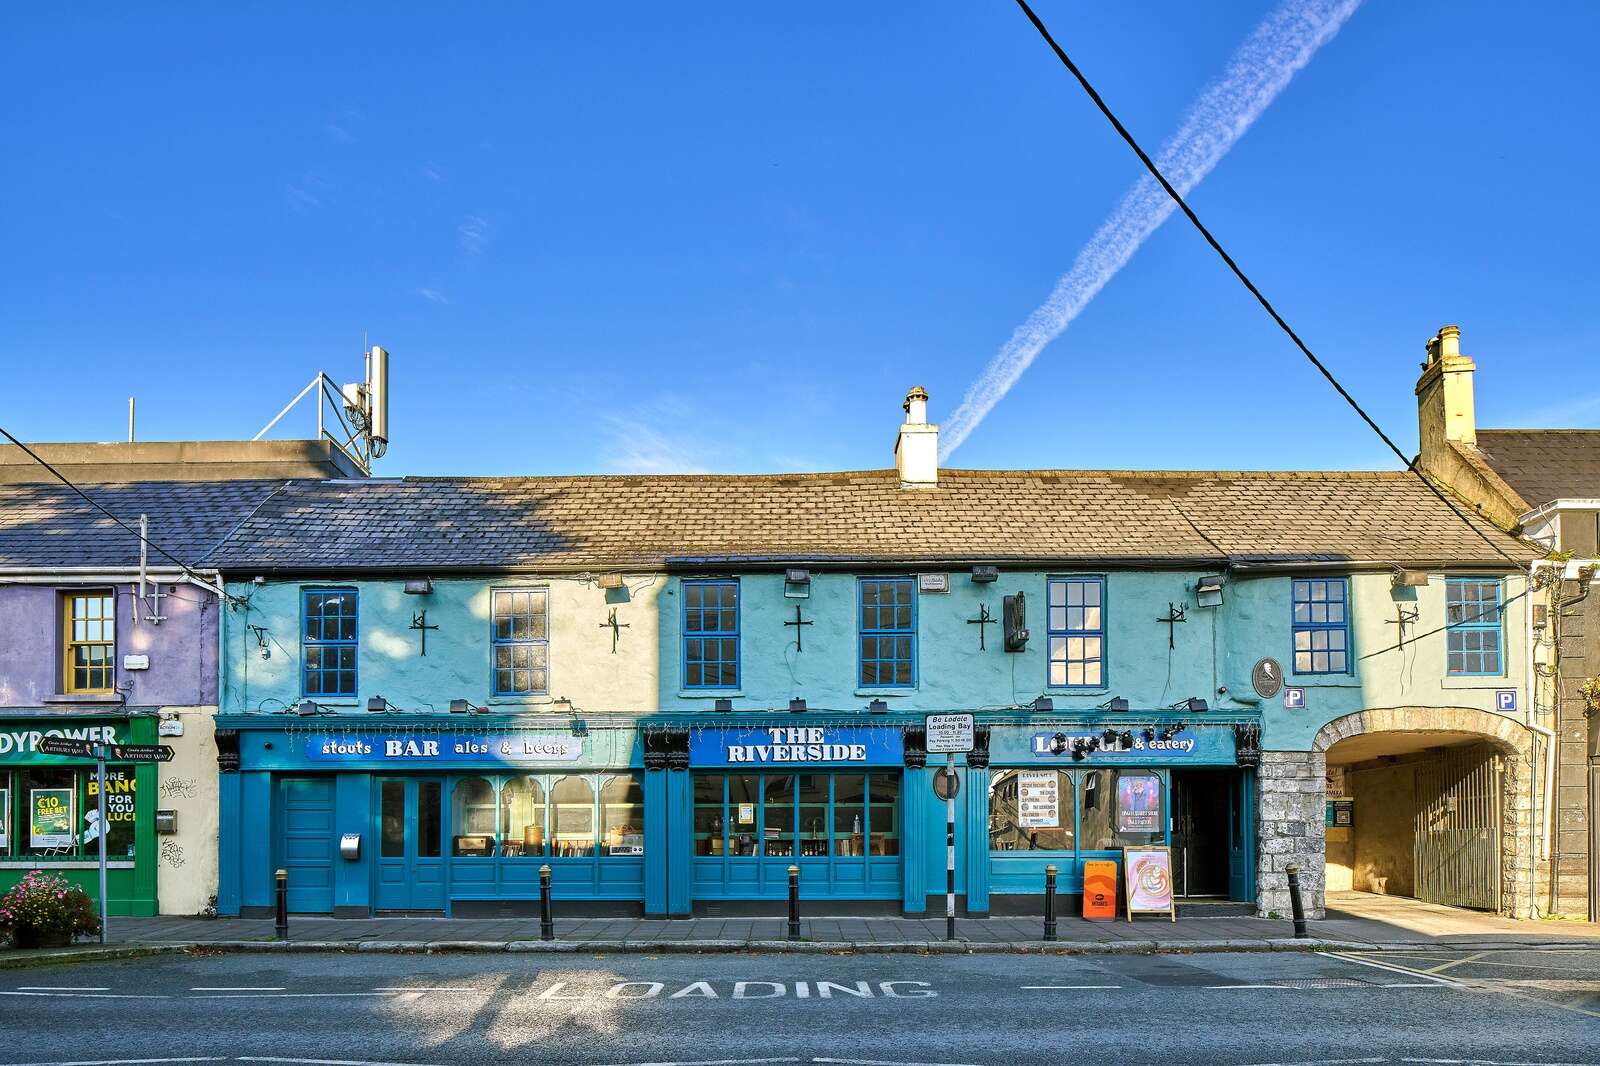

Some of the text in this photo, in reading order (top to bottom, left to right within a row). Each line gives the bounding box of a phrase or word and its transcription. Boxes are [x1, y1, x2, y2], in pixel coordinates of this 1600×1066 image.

[1290, 691, 1301, 705] P
[1501, 694, 1512, 708] P
[768, 727, 825, 744] THE
[322, 740, 570, 757] stouts BAR ales & beers
[1134, 738, 1145, 750] &
[1149, 738, 1194, 753] eatery
[728, 744, 867, 762] RIVERSIDE
[90, 772, 125, 780] MRE
[37, 796, 59, 809] €10
[108, 795, 132, 804] FOR
[37, 805, 68, 816] FREE BET
[536, 981, 939, 1000] LOADING
